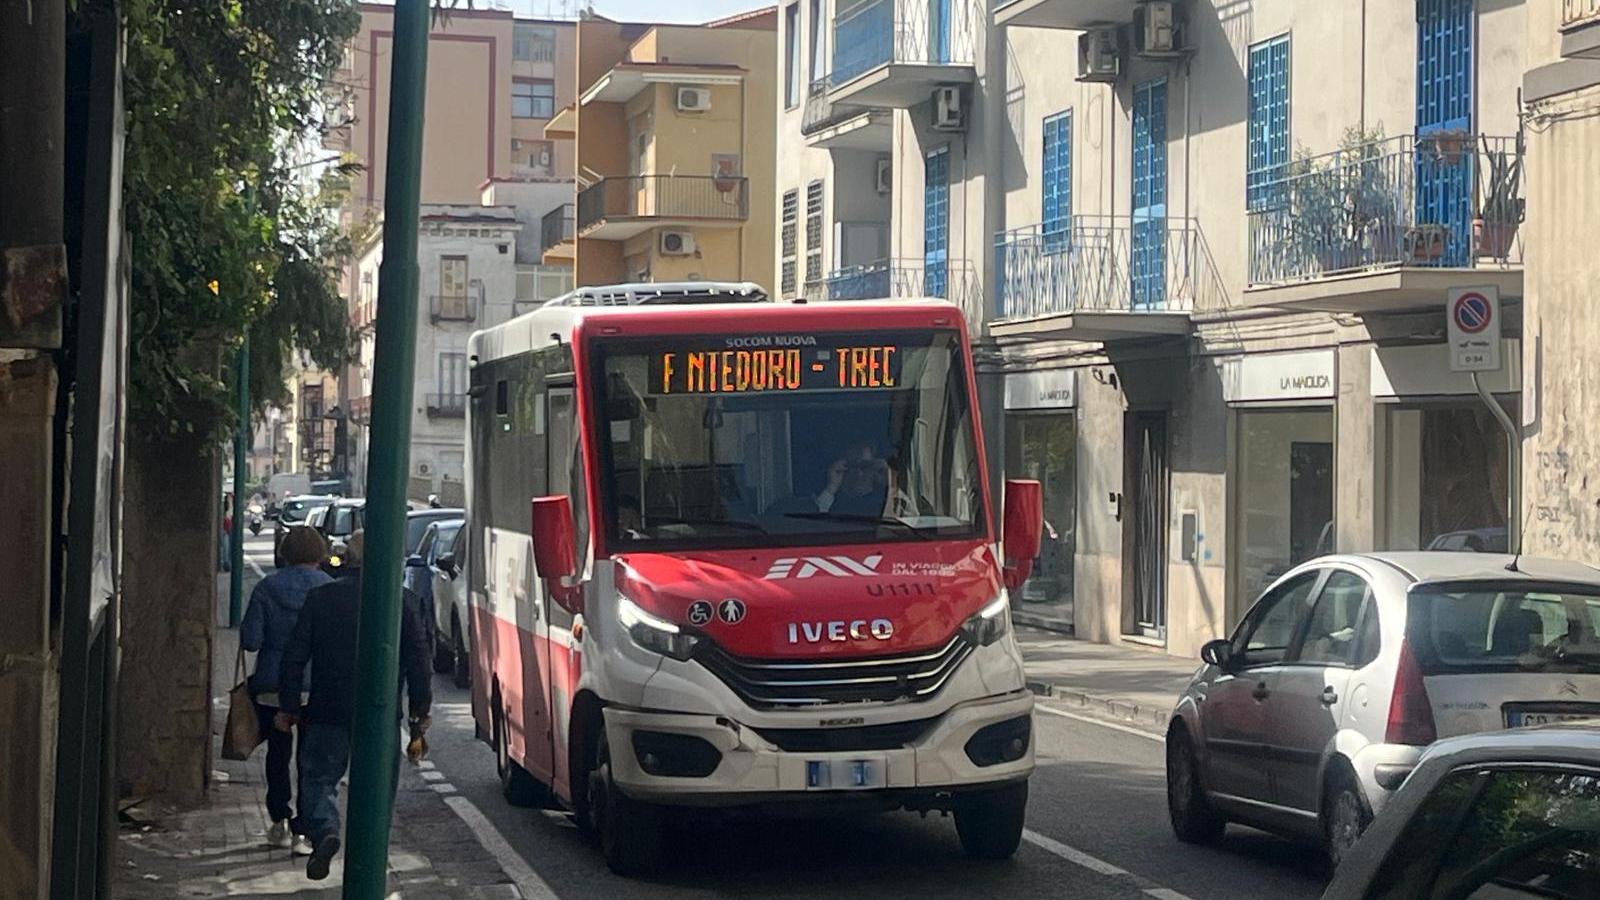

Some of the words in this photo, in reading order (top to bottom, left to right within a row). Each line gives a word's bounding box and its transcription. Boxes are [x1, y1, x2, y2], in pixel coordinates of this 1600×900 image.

[726, 337, 772, 350] SOCOM
[775, 336, 817, 347] NUOVA
[836, 346, 896, 388] TREC
[1280, 377, 1291, 390] LA
[866, 583, 936, 597] U1111
[787, 618, 895, 644] IVECO
